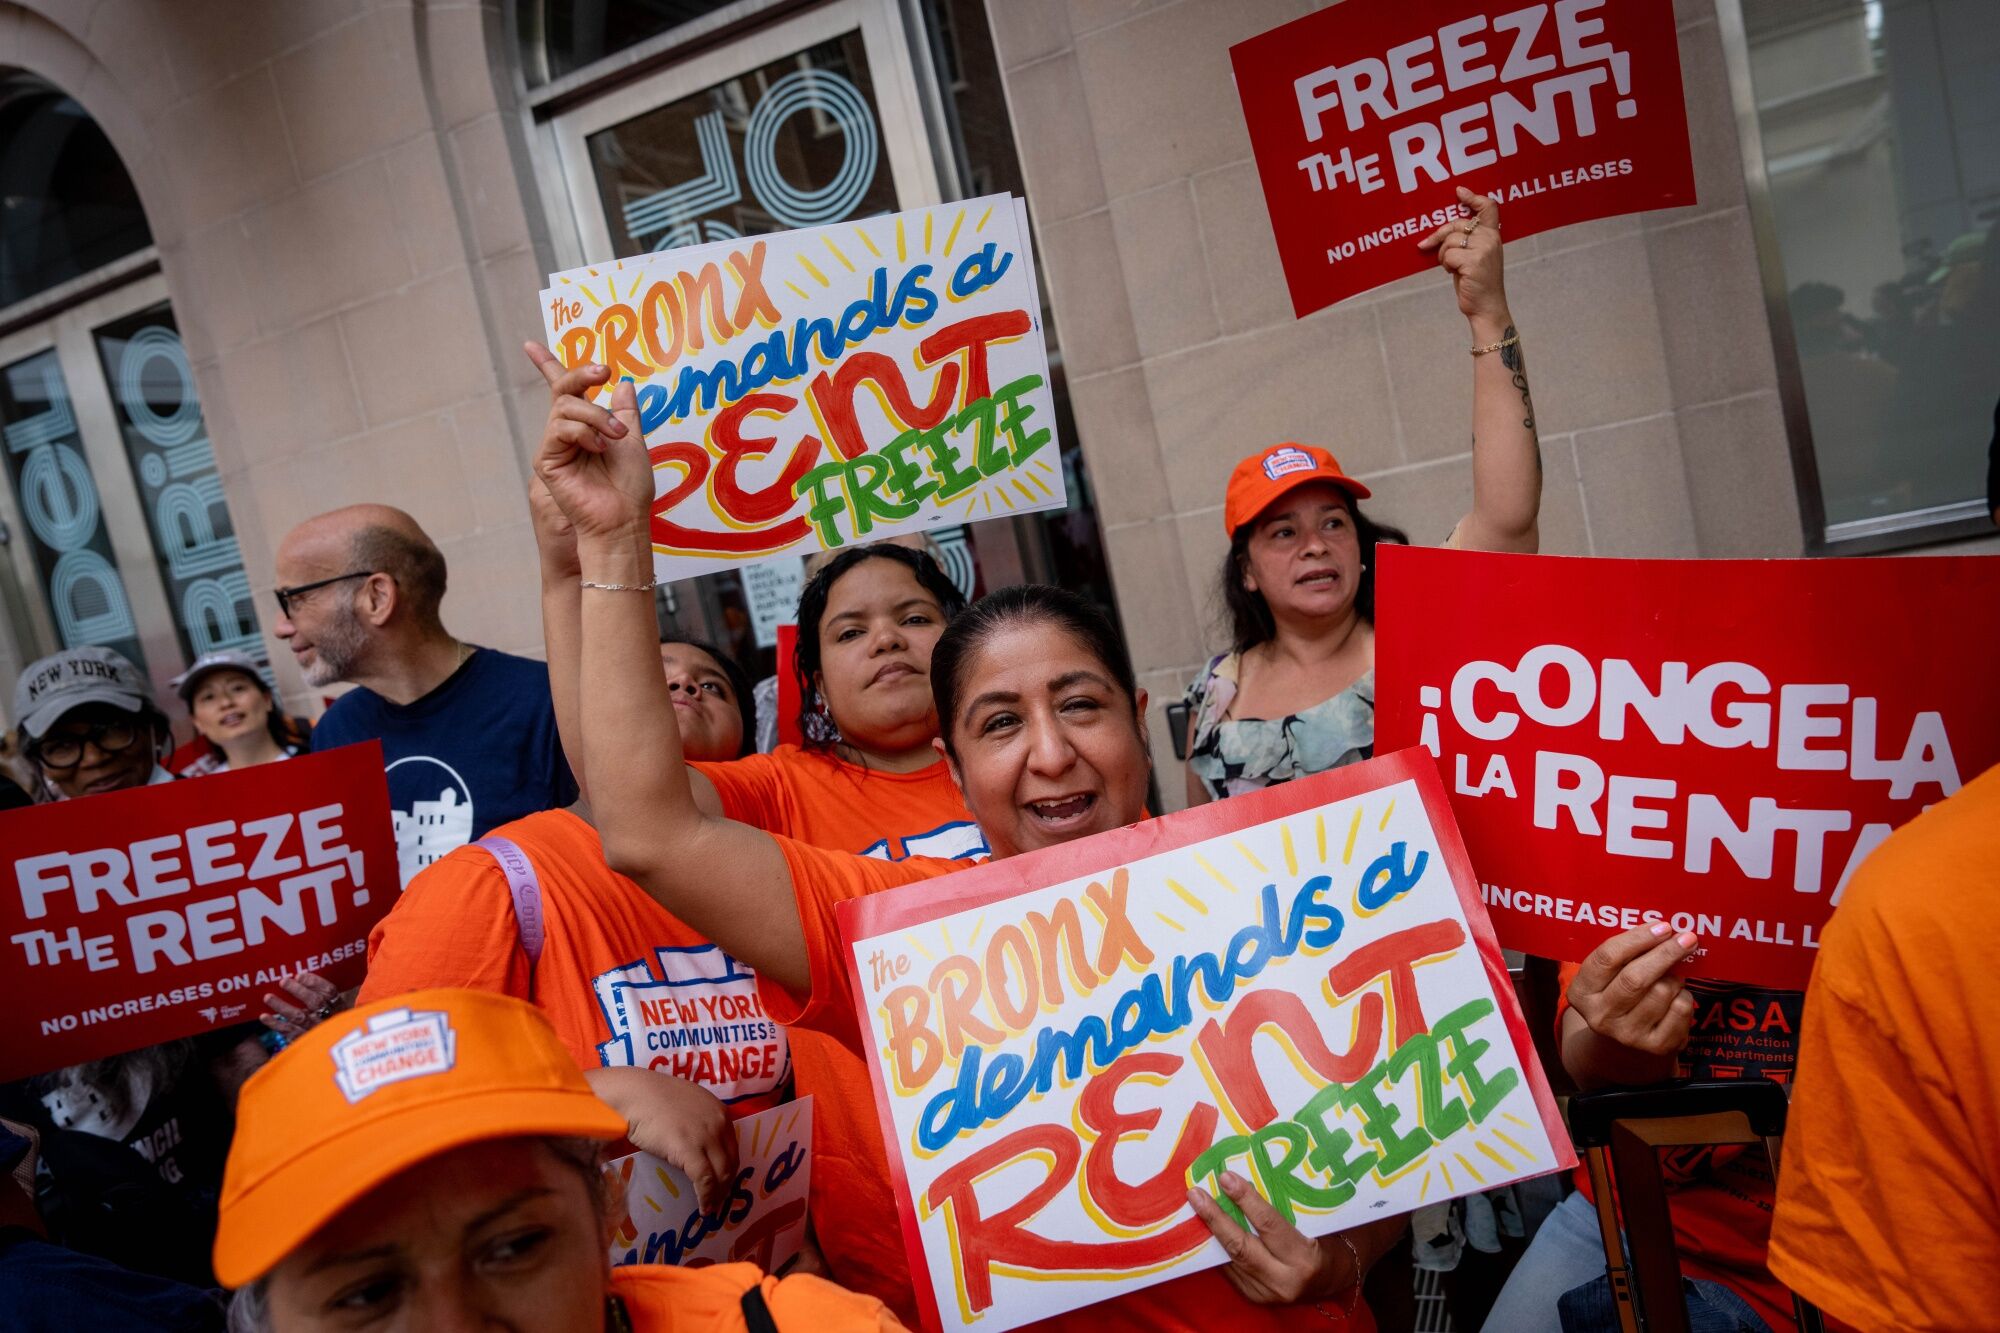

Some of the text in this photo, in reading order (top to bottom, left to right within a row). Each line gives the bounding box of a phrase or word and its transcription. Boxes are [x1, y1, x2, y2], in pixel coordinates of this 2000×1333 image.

[1294, 0, 1614, 142] FREEZE
[1298, 50, 1638, 195] THE RENT!
[1327, 242, 1356, 264] NO
[1358, 202, 1471, 252] INCREASES
[1508, 177, 1547, 202] ALL
[1549, 158, 1633, 190] LEASES
[551, 297, 585, 332] the
[607, 242, 1015, 435] emands a
[797, 374, 1052, 547] FREEZE
[28, 658, 121, 701] NEW YORK
[1455, 753, 1518, 799] LA
[14, 803, 352, 920] FREEZE
[11, 849, 371, 975] THE RENT!
[1670, 911, 1722, 937] ON
[1729, 918, 1794, 946] ALL
[40, 1015, 79, 1037] NO
[82, 983, 214, 1027] INCREASES
[217, 973, 251, 995] ON
[254, 963, 294, 987] ALL
[295, 938, 367, 975] LEASES
[640, 998, 699, 1027] NEW
[868, 948, 912, 992] the
[919, 841, 1429, 1151] demands a
[646, 1022, 768, 1051] COMMUNITIES
[1715, 1047, 1795, 1062] Apartments
[1744, 1035, 1791, 1048] Action
[1191, 997, 1519, 1233] FREEZE
